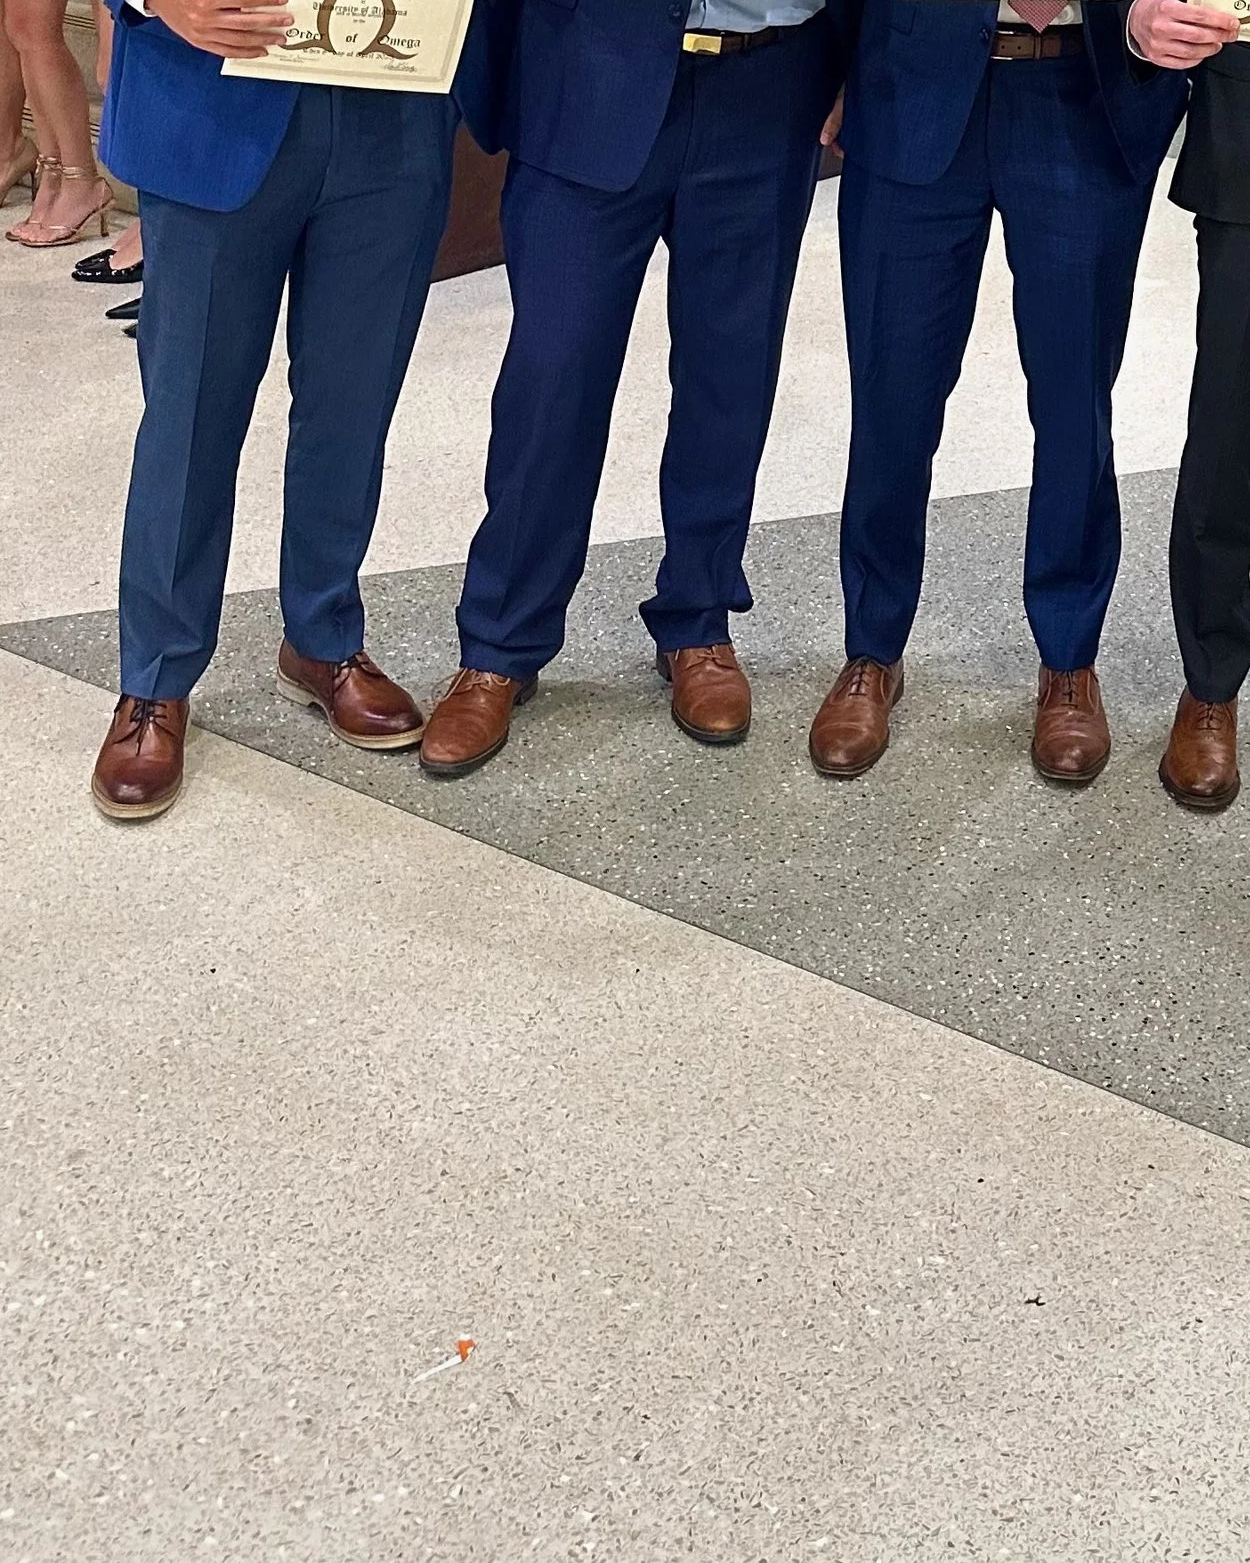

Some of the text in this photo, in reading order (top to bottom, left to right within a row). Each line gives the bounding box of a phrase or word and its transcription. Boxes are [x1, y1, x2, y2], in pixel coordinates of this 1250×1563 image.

[285, 27, 421, 49] Order of Omega
